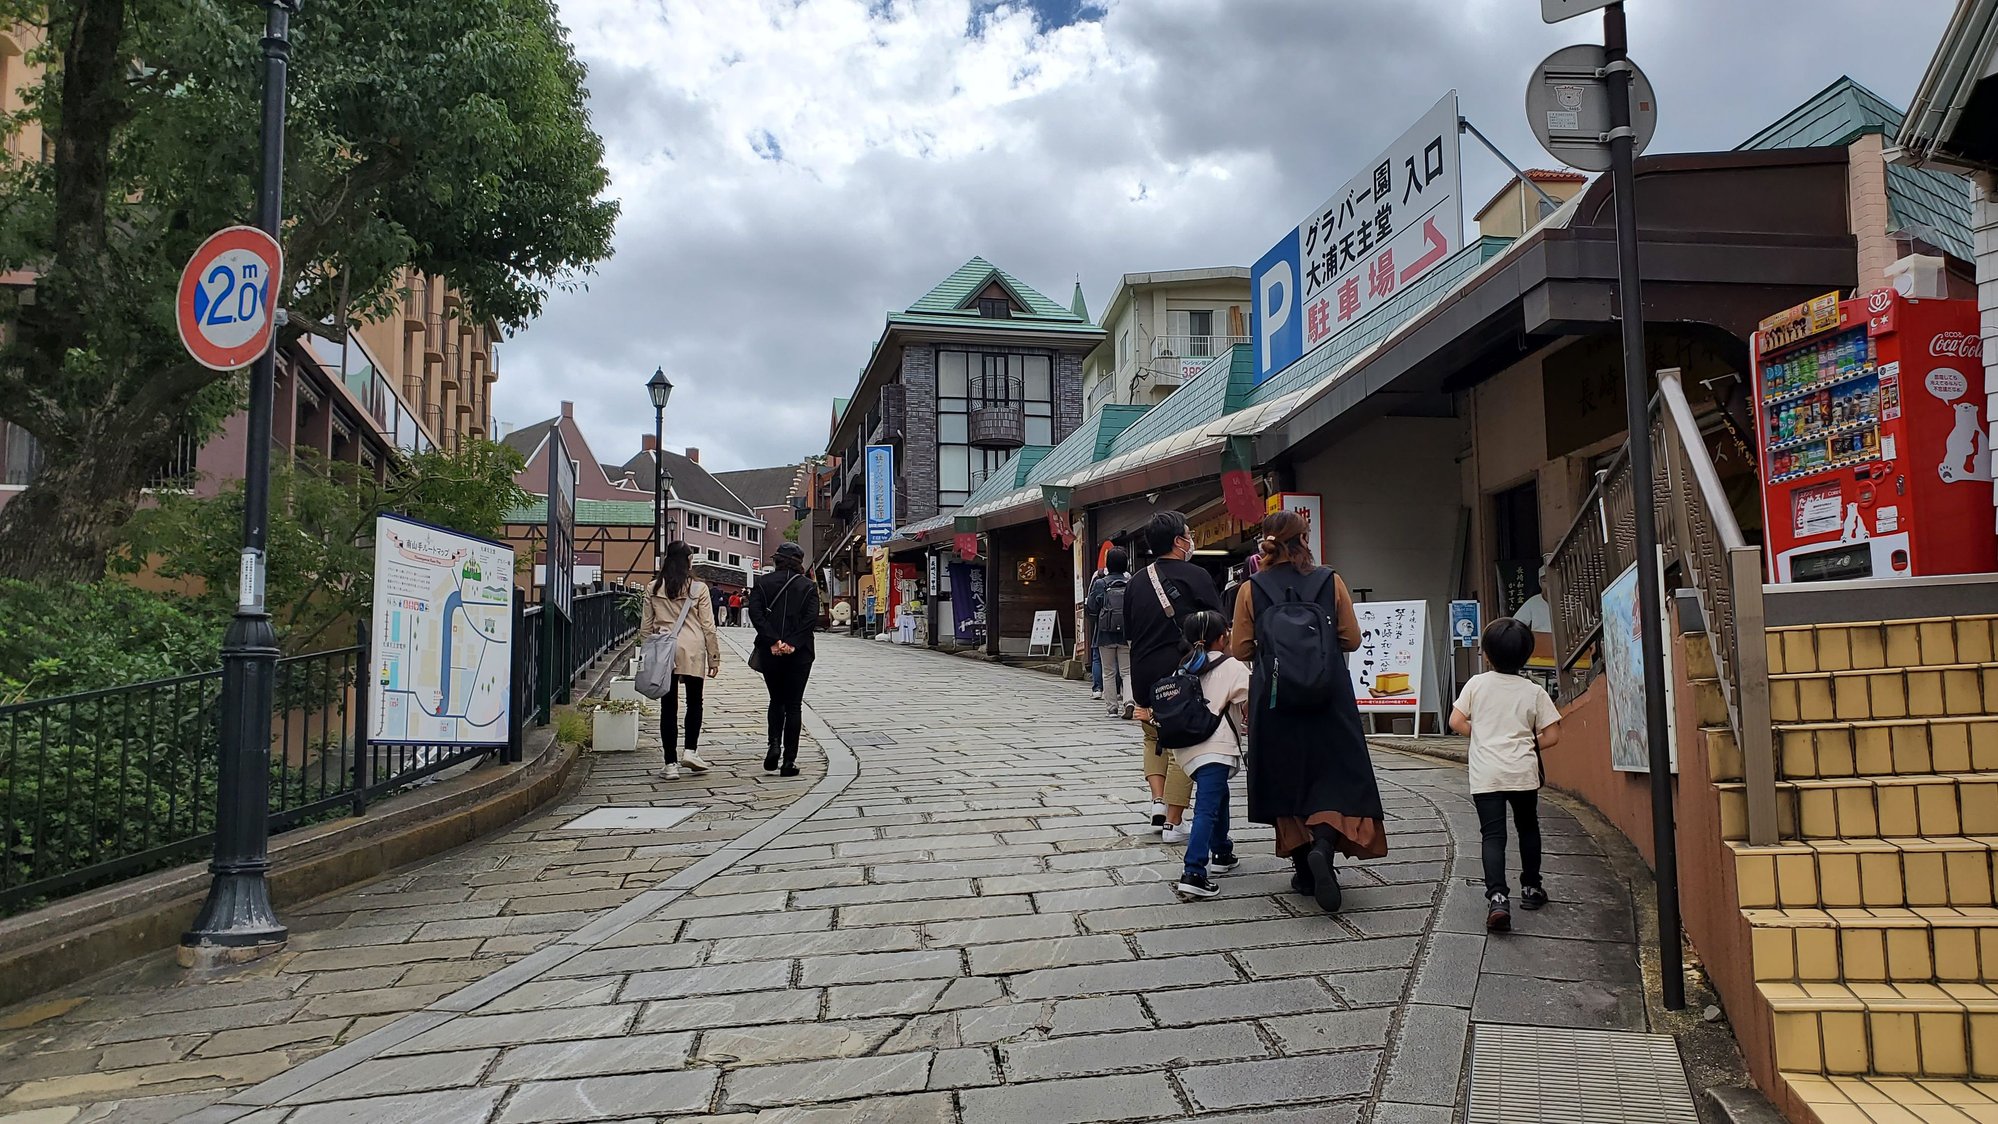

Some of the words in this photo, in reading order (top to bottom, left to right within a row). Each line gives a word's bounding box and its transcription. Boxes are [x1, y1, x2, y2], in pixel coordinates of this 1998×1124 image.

[1305, 156, 1391, 257] グラバー園
[1402, 134, 1443, 207] 入口
[243, 264, 257, 279] m
[1305, 201, 1393, 297] 大浦天主堂
[206, 265, 257, 325] 2.0
[1259, 259, 1294, 374] P
[1306, 247, 1395, 344] 駐車場
[1507, 582, 1516, 611] かすてら
[1359, 628, 1381, 688] かすてら
